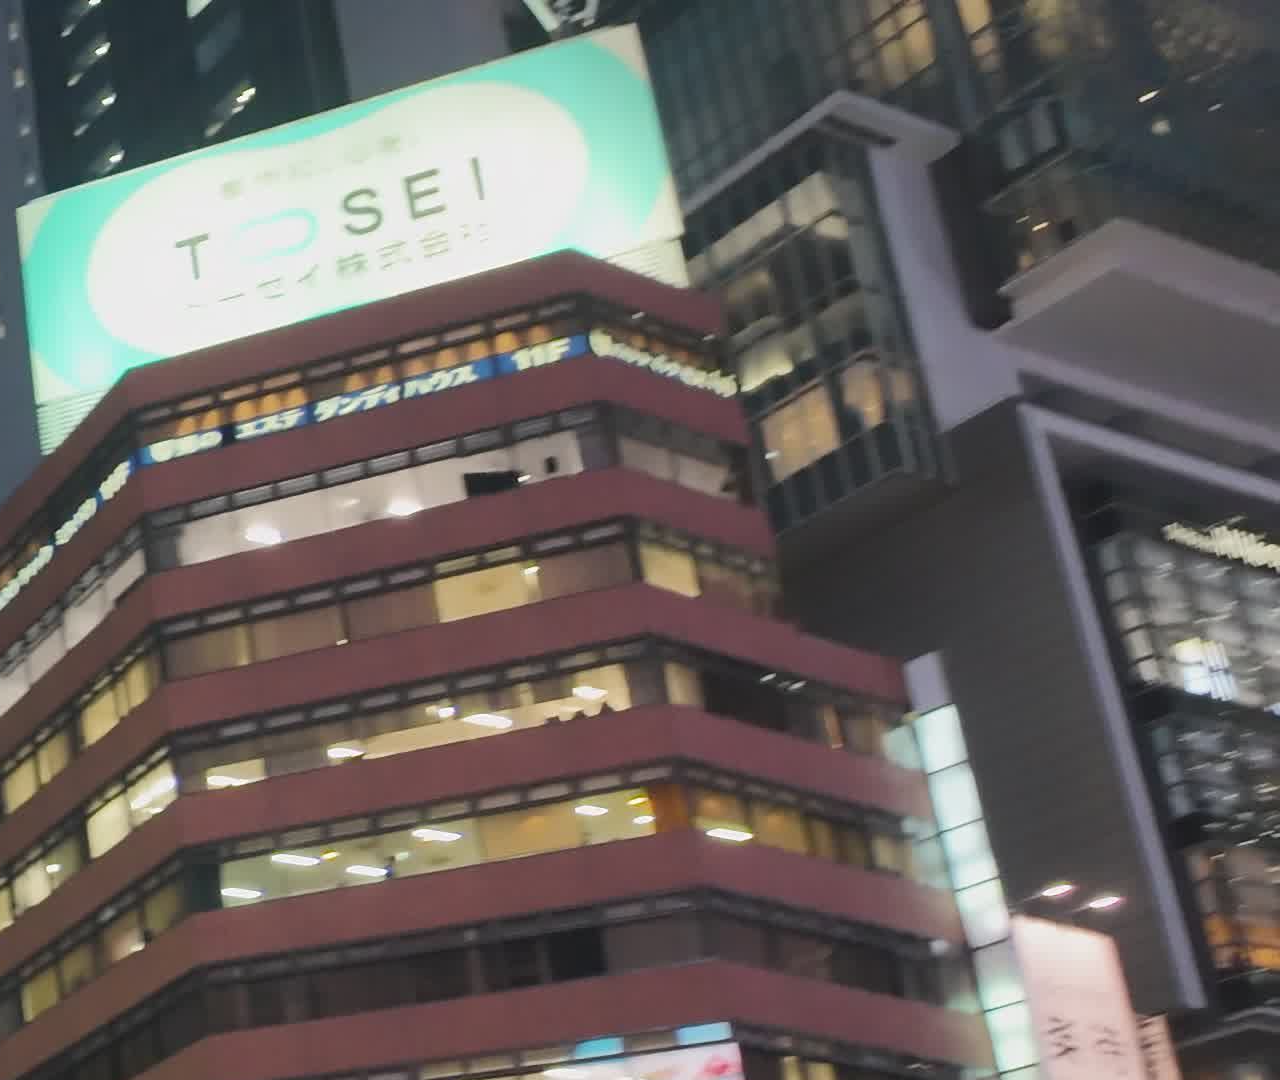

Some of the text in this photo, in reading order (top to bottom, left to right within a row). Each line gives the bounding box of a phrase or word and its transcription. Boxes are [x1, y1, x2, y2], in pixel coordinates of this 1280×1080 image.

[187, 221, 490, 310] ーセイ株式会社
